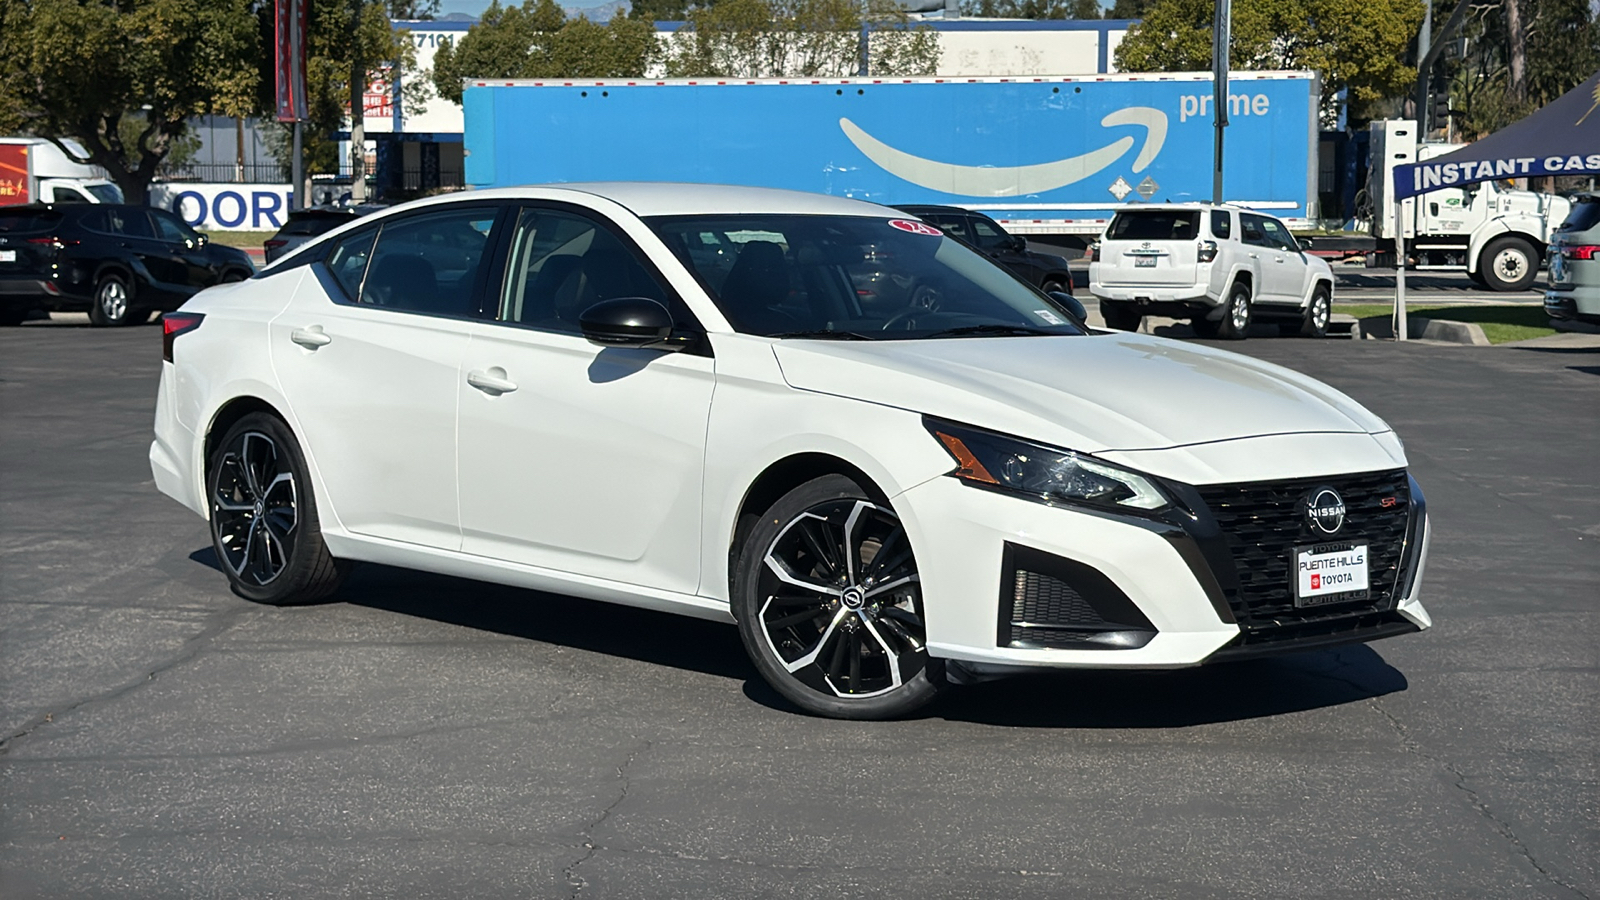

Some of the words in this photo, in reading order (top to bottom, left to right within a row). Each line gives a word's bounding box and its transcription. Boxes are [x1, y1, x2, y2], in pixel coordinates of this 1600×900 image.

[411, 33, 455, 49] 7101
[1180, 94, 1270, 123] prme
[1414, 157, 1535, 191] INSTANT
[1544, 154, 1600, 171] CAS
[1381, 497, 1396, 507] SR
[1308, 506, 1346, 518] NISSAN
[1300, 558, 1336, 571] PUENTE
[1337, 555, 1364, 566] HILLS
[1322, 573, 1352, 585] TOYOTA
